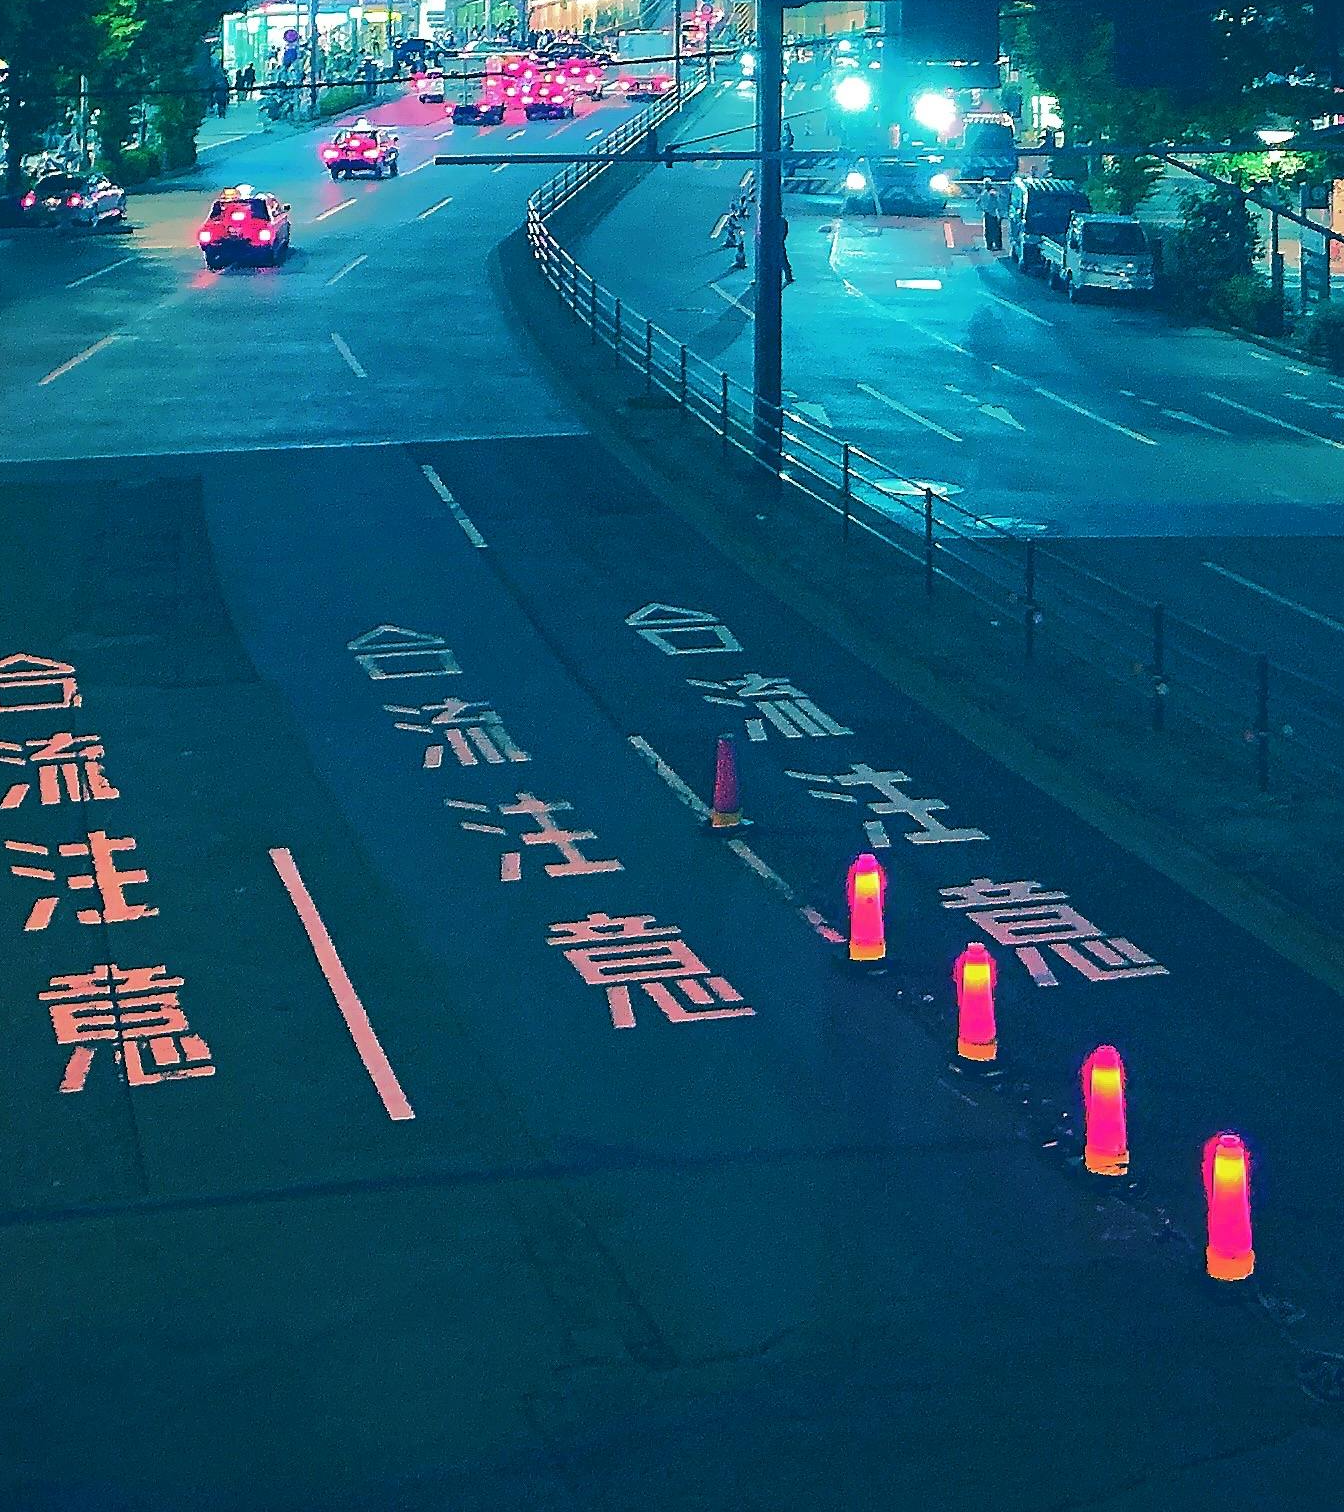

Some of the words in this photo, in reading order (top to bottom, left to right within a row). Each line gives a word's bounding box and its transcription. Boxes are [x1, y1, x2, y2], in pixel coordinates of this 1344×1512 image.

[347, 623, 758, 1030] 合流注意
[625, 601, 1172, 988] 合流注意
